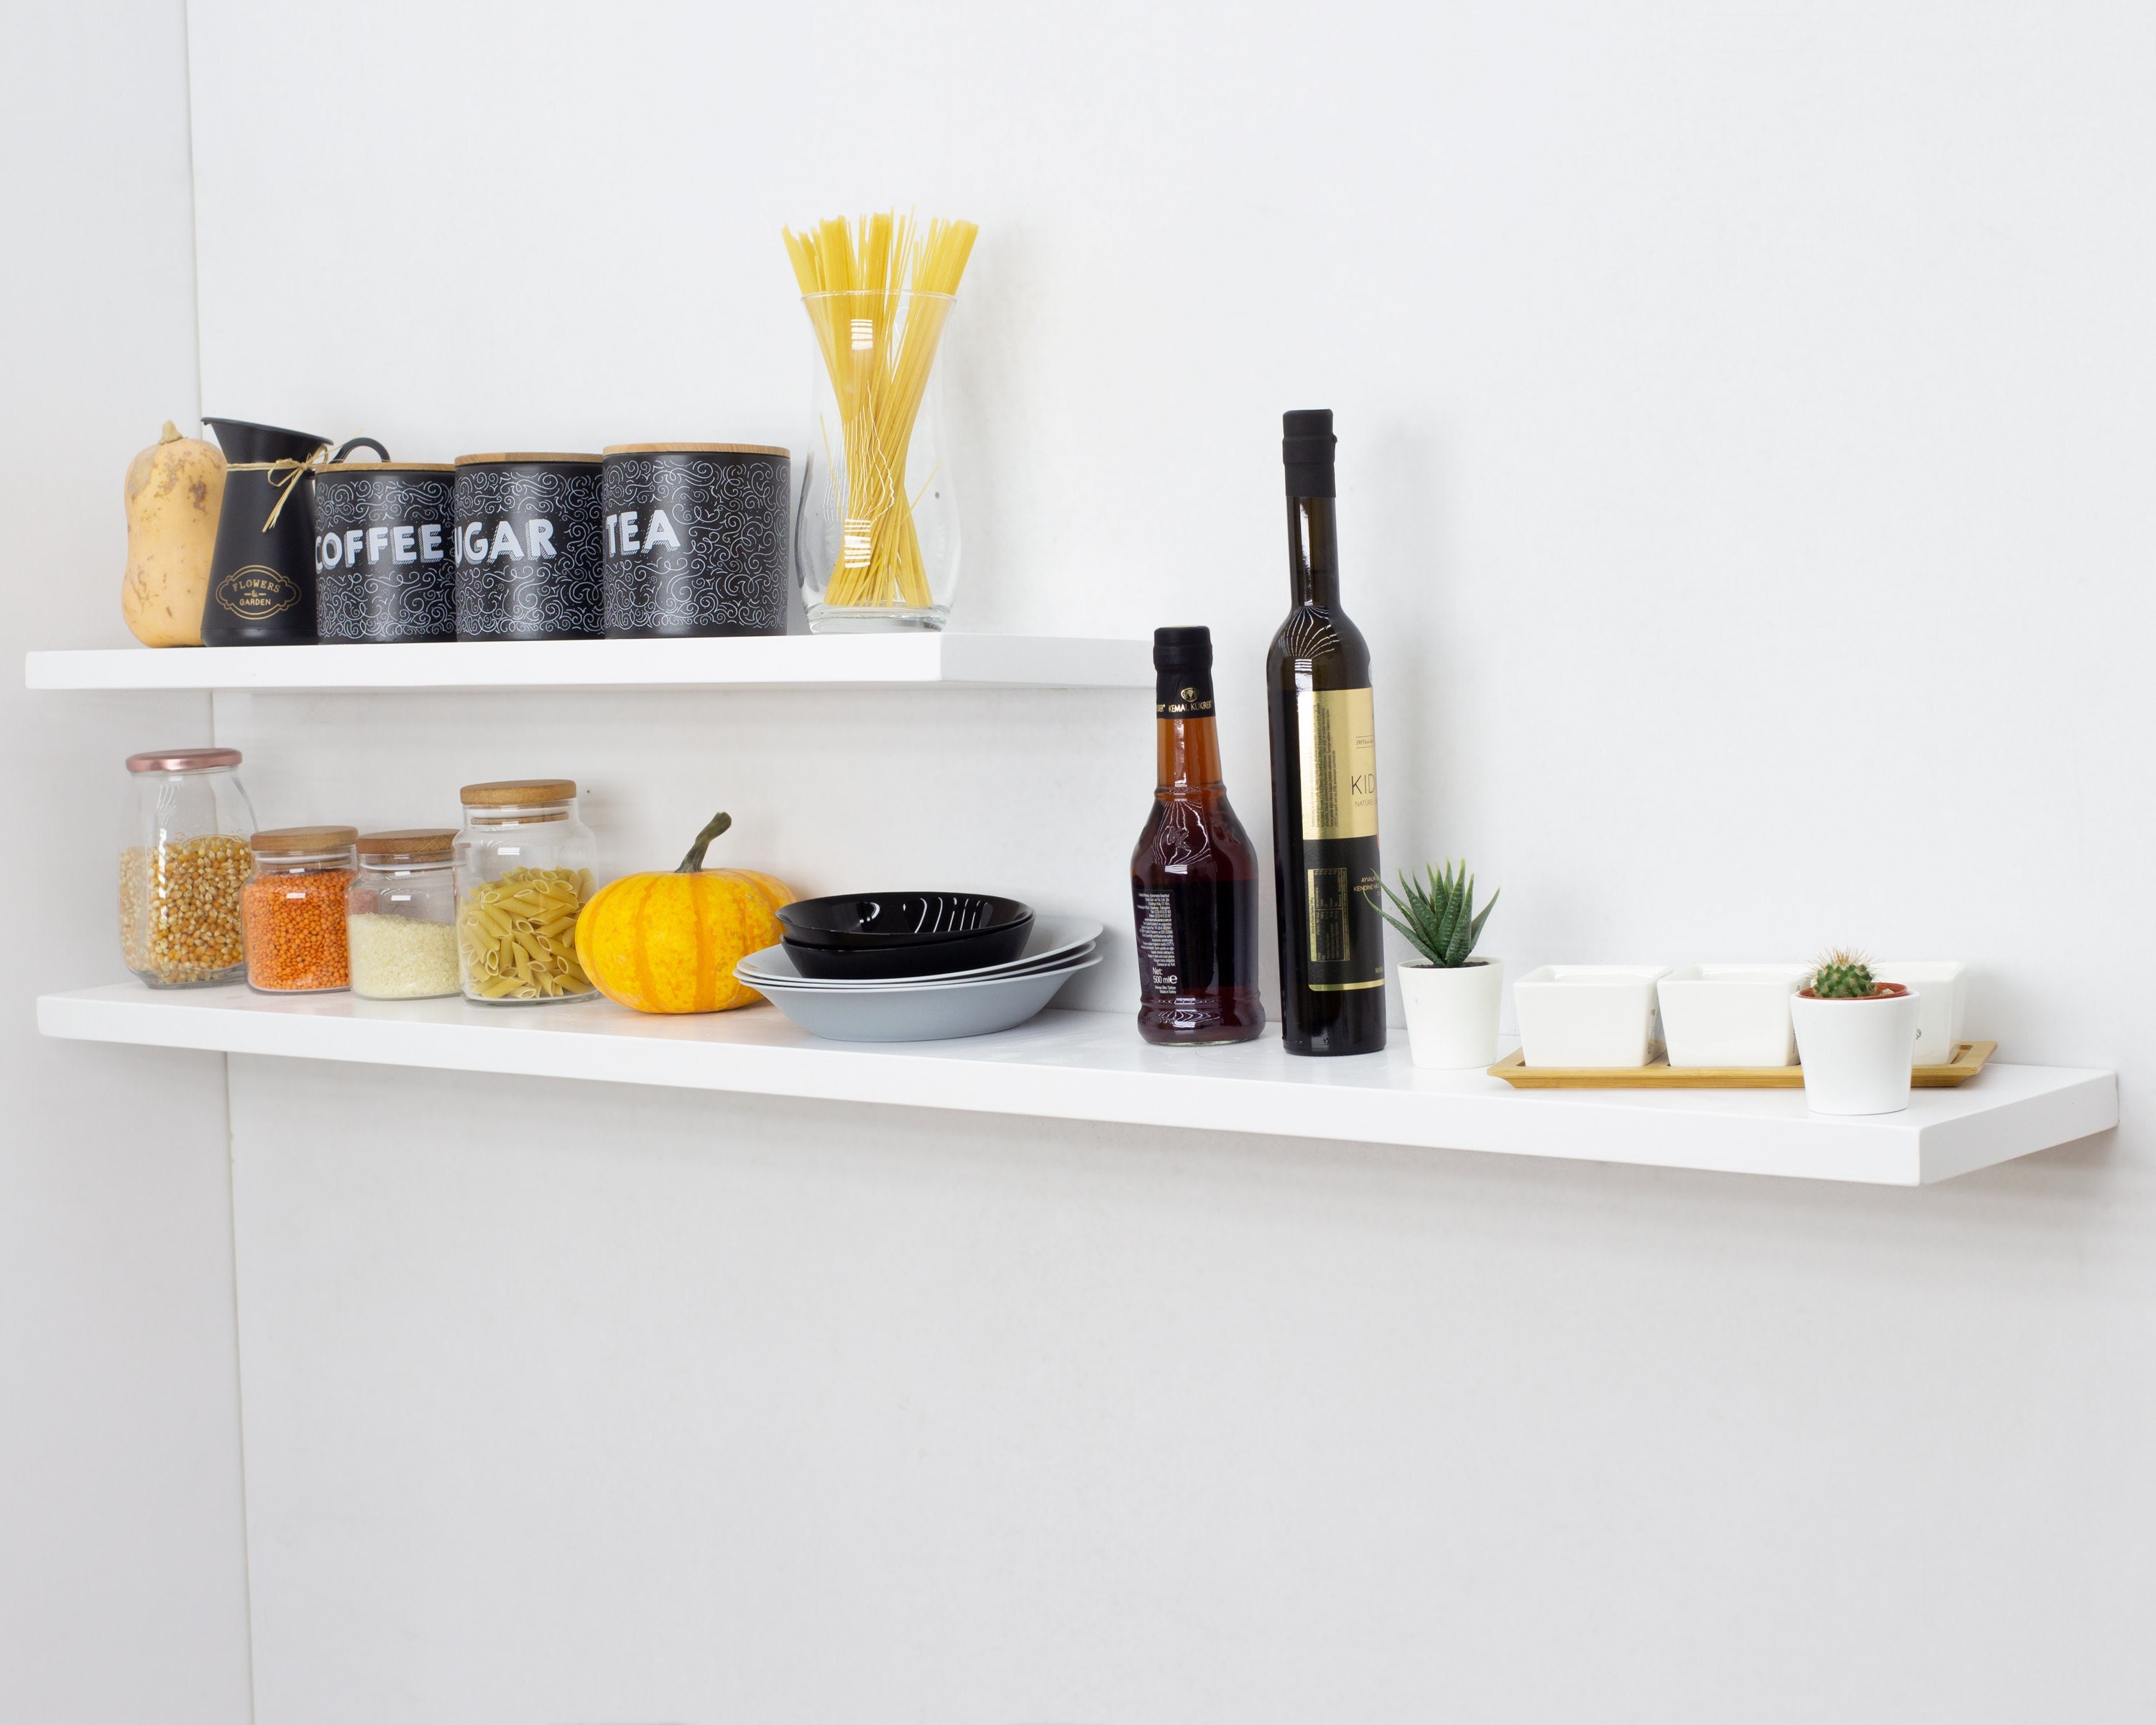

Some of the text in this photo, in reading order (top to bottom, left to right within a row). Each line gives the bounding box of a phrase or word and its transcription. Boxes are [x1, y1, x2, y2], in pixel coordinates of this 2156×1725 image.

[606, 510, 681, 558] TEA
[315, 524, 444, 574] COFFEE
[232, 579, 281, 593] FLOWERS
[251, 589, 259, 598] &
[1168, 704, 1189, 712] KEMAL
[1153, 975, 1162, 984] 500
